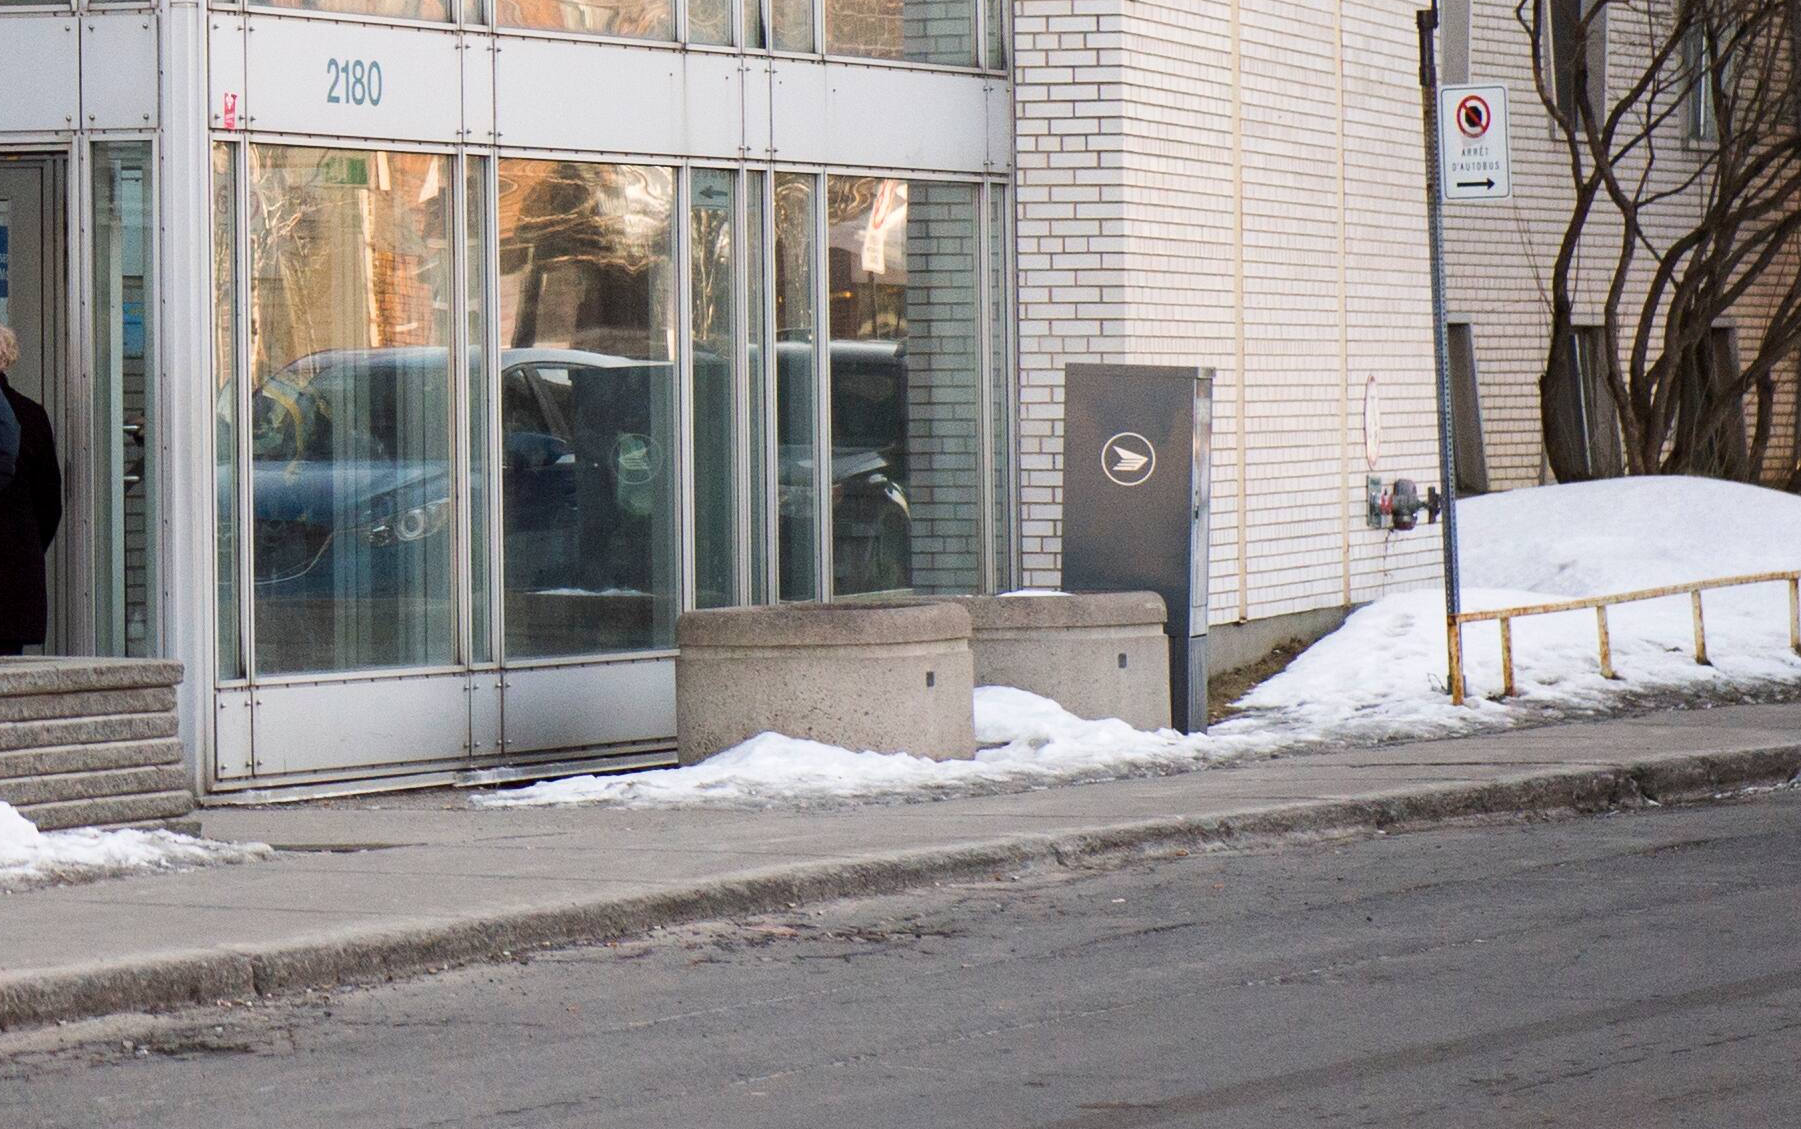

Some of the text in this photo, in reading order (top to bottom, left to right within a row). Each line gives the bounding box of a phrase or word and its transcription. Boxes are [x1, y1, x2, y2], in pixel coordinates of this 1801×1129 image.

[326, 57, 383, 107] 2180
[1461, 145, 1489, 157] ARRÊT
[1451, 160, 1500, 172] D'AUTOBUS
